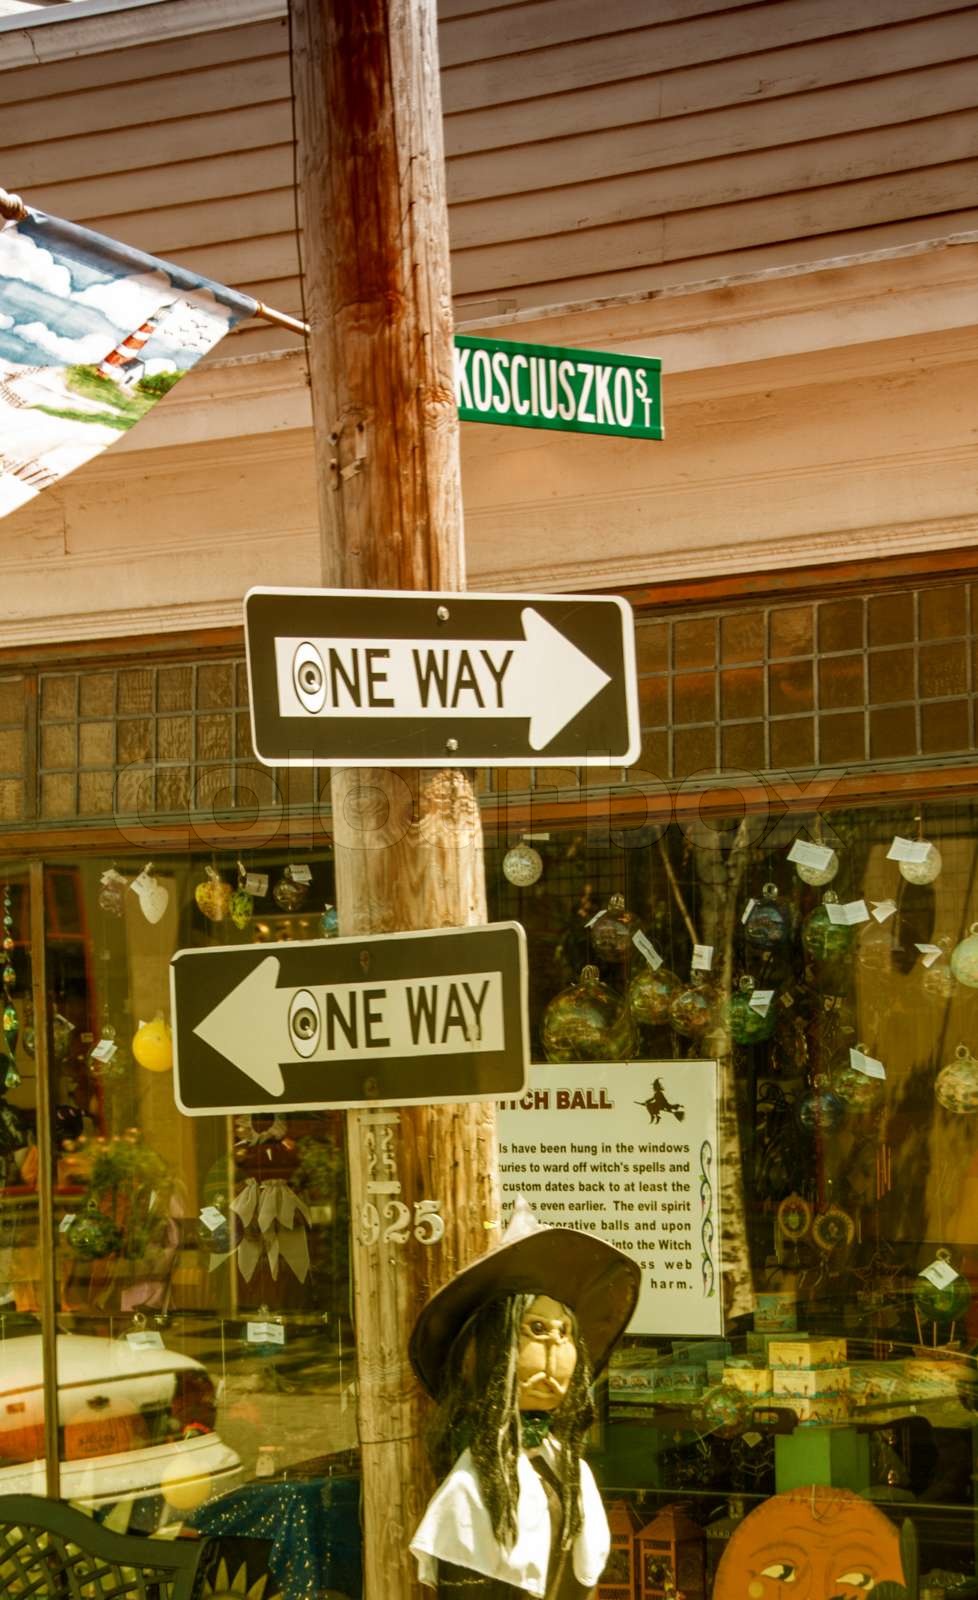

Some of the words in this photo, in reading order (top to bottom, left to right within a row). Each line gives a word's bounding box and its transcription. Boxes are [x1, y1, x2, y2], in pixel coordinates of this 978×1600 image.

[454, 347, 634, 428] KOSCIUSZKO
[412, 648, 515, 708] WAY
[405, 980, 491, 1045] WAY
[556, 1090, 613, 1110] BALL
[512, 1143, 536, 1153] have
[541, 1143, 566, 1153] been
[571, 1143, 597, 1155] hung
[602, 1143, 611, 1152] in
[616, 1143, 634, 1153] the
[638, 1143, 689, 1152] windows
[499, 1162, 526, 1172] uries
[530, 1163, 540, 1172] to
[543, 1162, 569, 1172] ward
[573, 1162, 587, 1172] off
[590, 1162, 629, 1172] witch's
[633, 1162, 665, 1174] spells
[669, 1162, 689, 1172] and
[503, 1182, 541, 1191] custom
[545, 1181, 575, 1191] dates
[579, 1182, 605, 1191] back
[609, 1182, 620, 1191] to
[624, 1182, 635, 1191] at
[639, 1181, 667, 1191] least
[672, 1181, 690, 1192] the
[540, 1202, 565, 1211] even
[568, 1201, 606, 1211] earlier.
[613, 1201, 634, 1211] The
[638, 1201, 657, 1211] evil
[661, 1201, 690, 1213] spirit
[360, 1200, 445, 1246] 925
[601, 1220, 629, 1230] balls
[635, 1220, 656, 1230] and
[662, 1223, 691, 1233] upon
[637, 1240, 655, 1250] the
[659, 1240, 691, 1250] Witch
[665, 1259, 692, 1269] web
[651, 1278, 693, 1289] harm.
